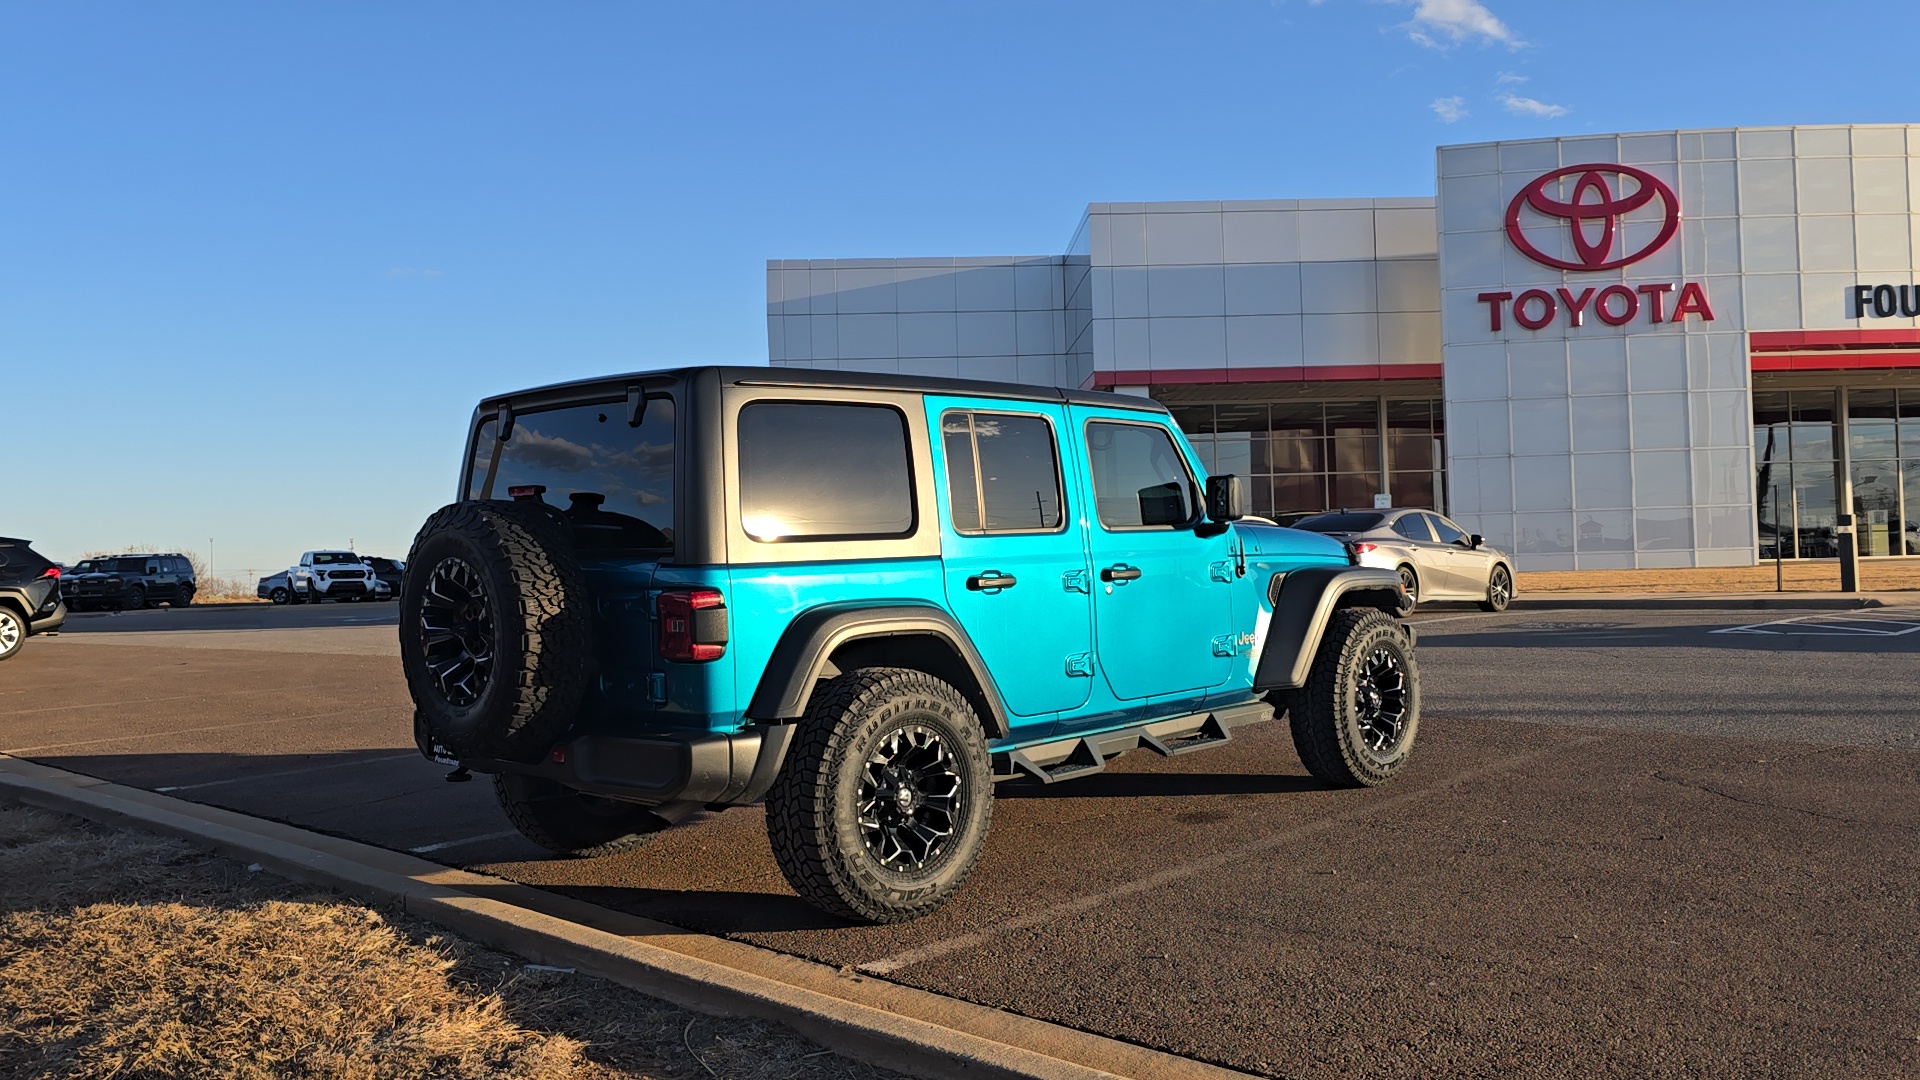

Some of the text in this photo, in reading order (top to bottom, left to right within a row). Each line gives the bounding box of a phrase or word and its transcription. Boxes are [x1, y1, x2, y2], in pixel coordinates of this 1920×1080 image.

[1478, 282, 1715, 332] TOYOTA
[1855, 284, 1920, 318] FOU
[855, 698, 954, 754] RUBITREK
[849, 852, 937, 902] FALKEN
